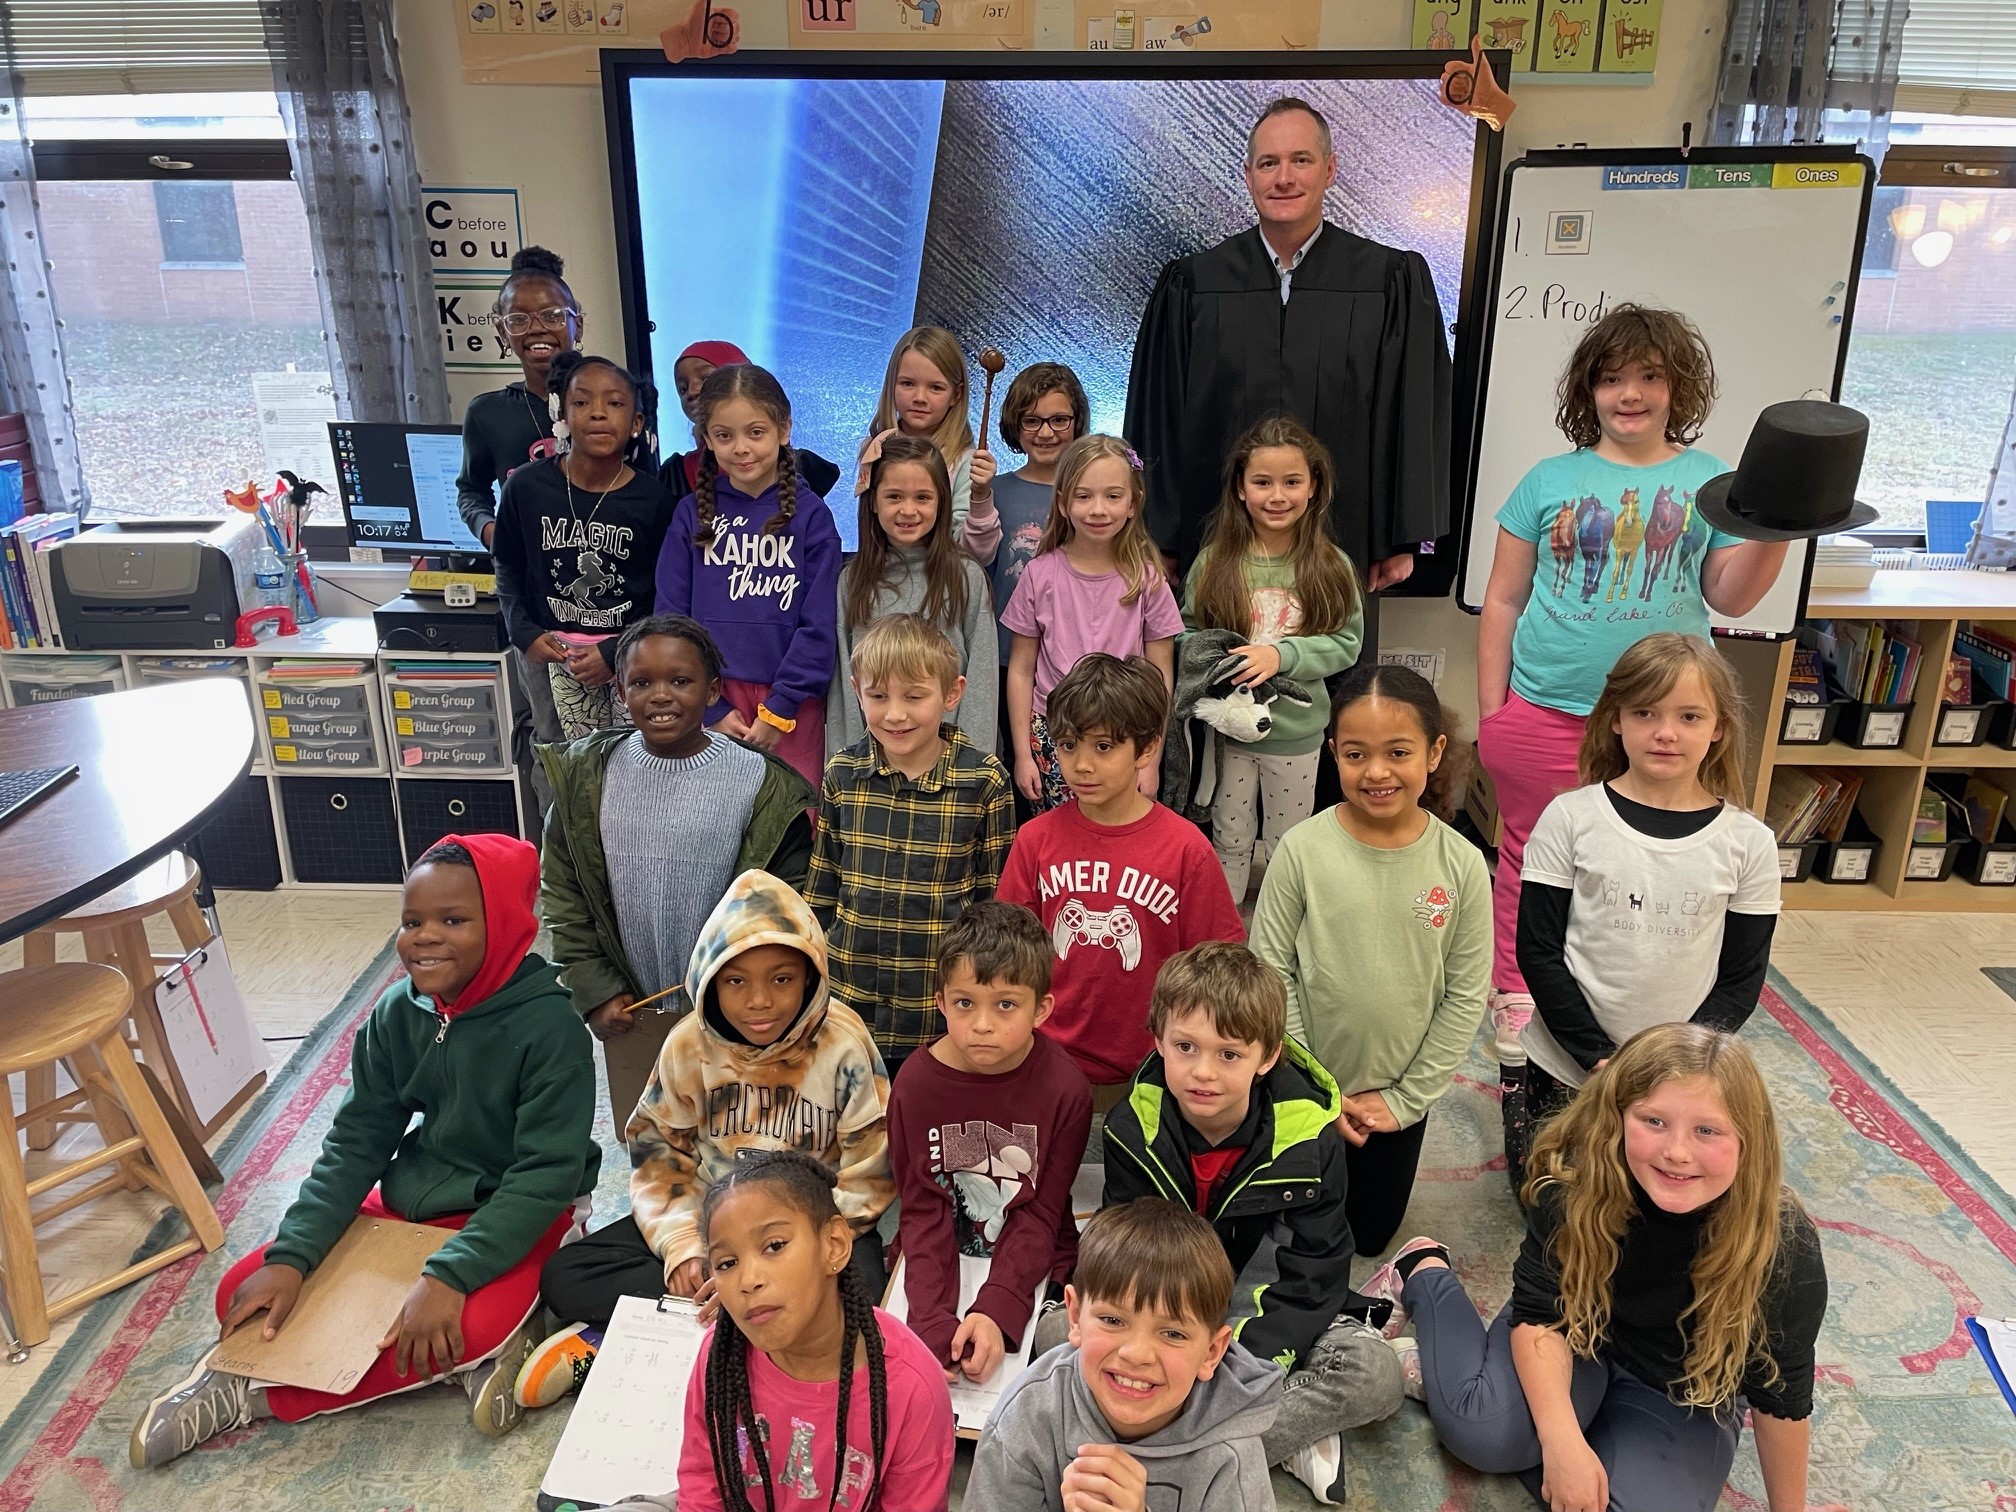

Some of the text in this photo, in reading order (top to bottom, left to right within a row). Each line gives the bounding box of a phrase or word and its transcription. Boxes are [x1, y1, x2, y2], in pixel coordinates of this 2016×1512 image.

[702, 0, 734, 48] b
[1089, 40, 1108, 50] au
[1145, 39, 1167, 49] aw
[1608, 168, 1839, 184] Hundreds Tens Ones
[425, 199, 507, 231] C before
[460, 240, 478, 258] o
[490, 241, 508, 258] u
[438, 296, 464, 325] K
[1505, 283, 1611, 323] 2. Prodi
[446, 328, 454, 352] i
[467, 335, 483, 352] e
[357, 524, 392, 537] 10:17
[711, 513, 748, 535] t's a
[541, 516, 634, 560] MAGIC
[703, 531, 796, 568] KAHOK
[728, 562, 800, 611] thing
[1607, 607, 1653, 623] Lake
[1406, 654, 1432, 668] SIT
[282, 693, 304, 705] Red
[306, 693, 341, 709] Group
[441, 693, 475, 709] Group
[288, 724, 320, 736] range
[322, 721, 357, 737] Group
[414, 720, 440, 733] Blue
[442, 721, 476, 736] Group
[298, 749, 324, 761] llow
[326, 748, 360, 763] Group
[423, 748, 486, 763] urple Group
[1038, 861, 1180, 925] AMER DUDE
[1613, 919, 1702, 937] BODY DIVERSITY
[709, 1082, 836, 1152] ERCROMBIE
[212, 1355, 258, 1372] Stearns
[1326, 1368, 1359, 1391] 19
